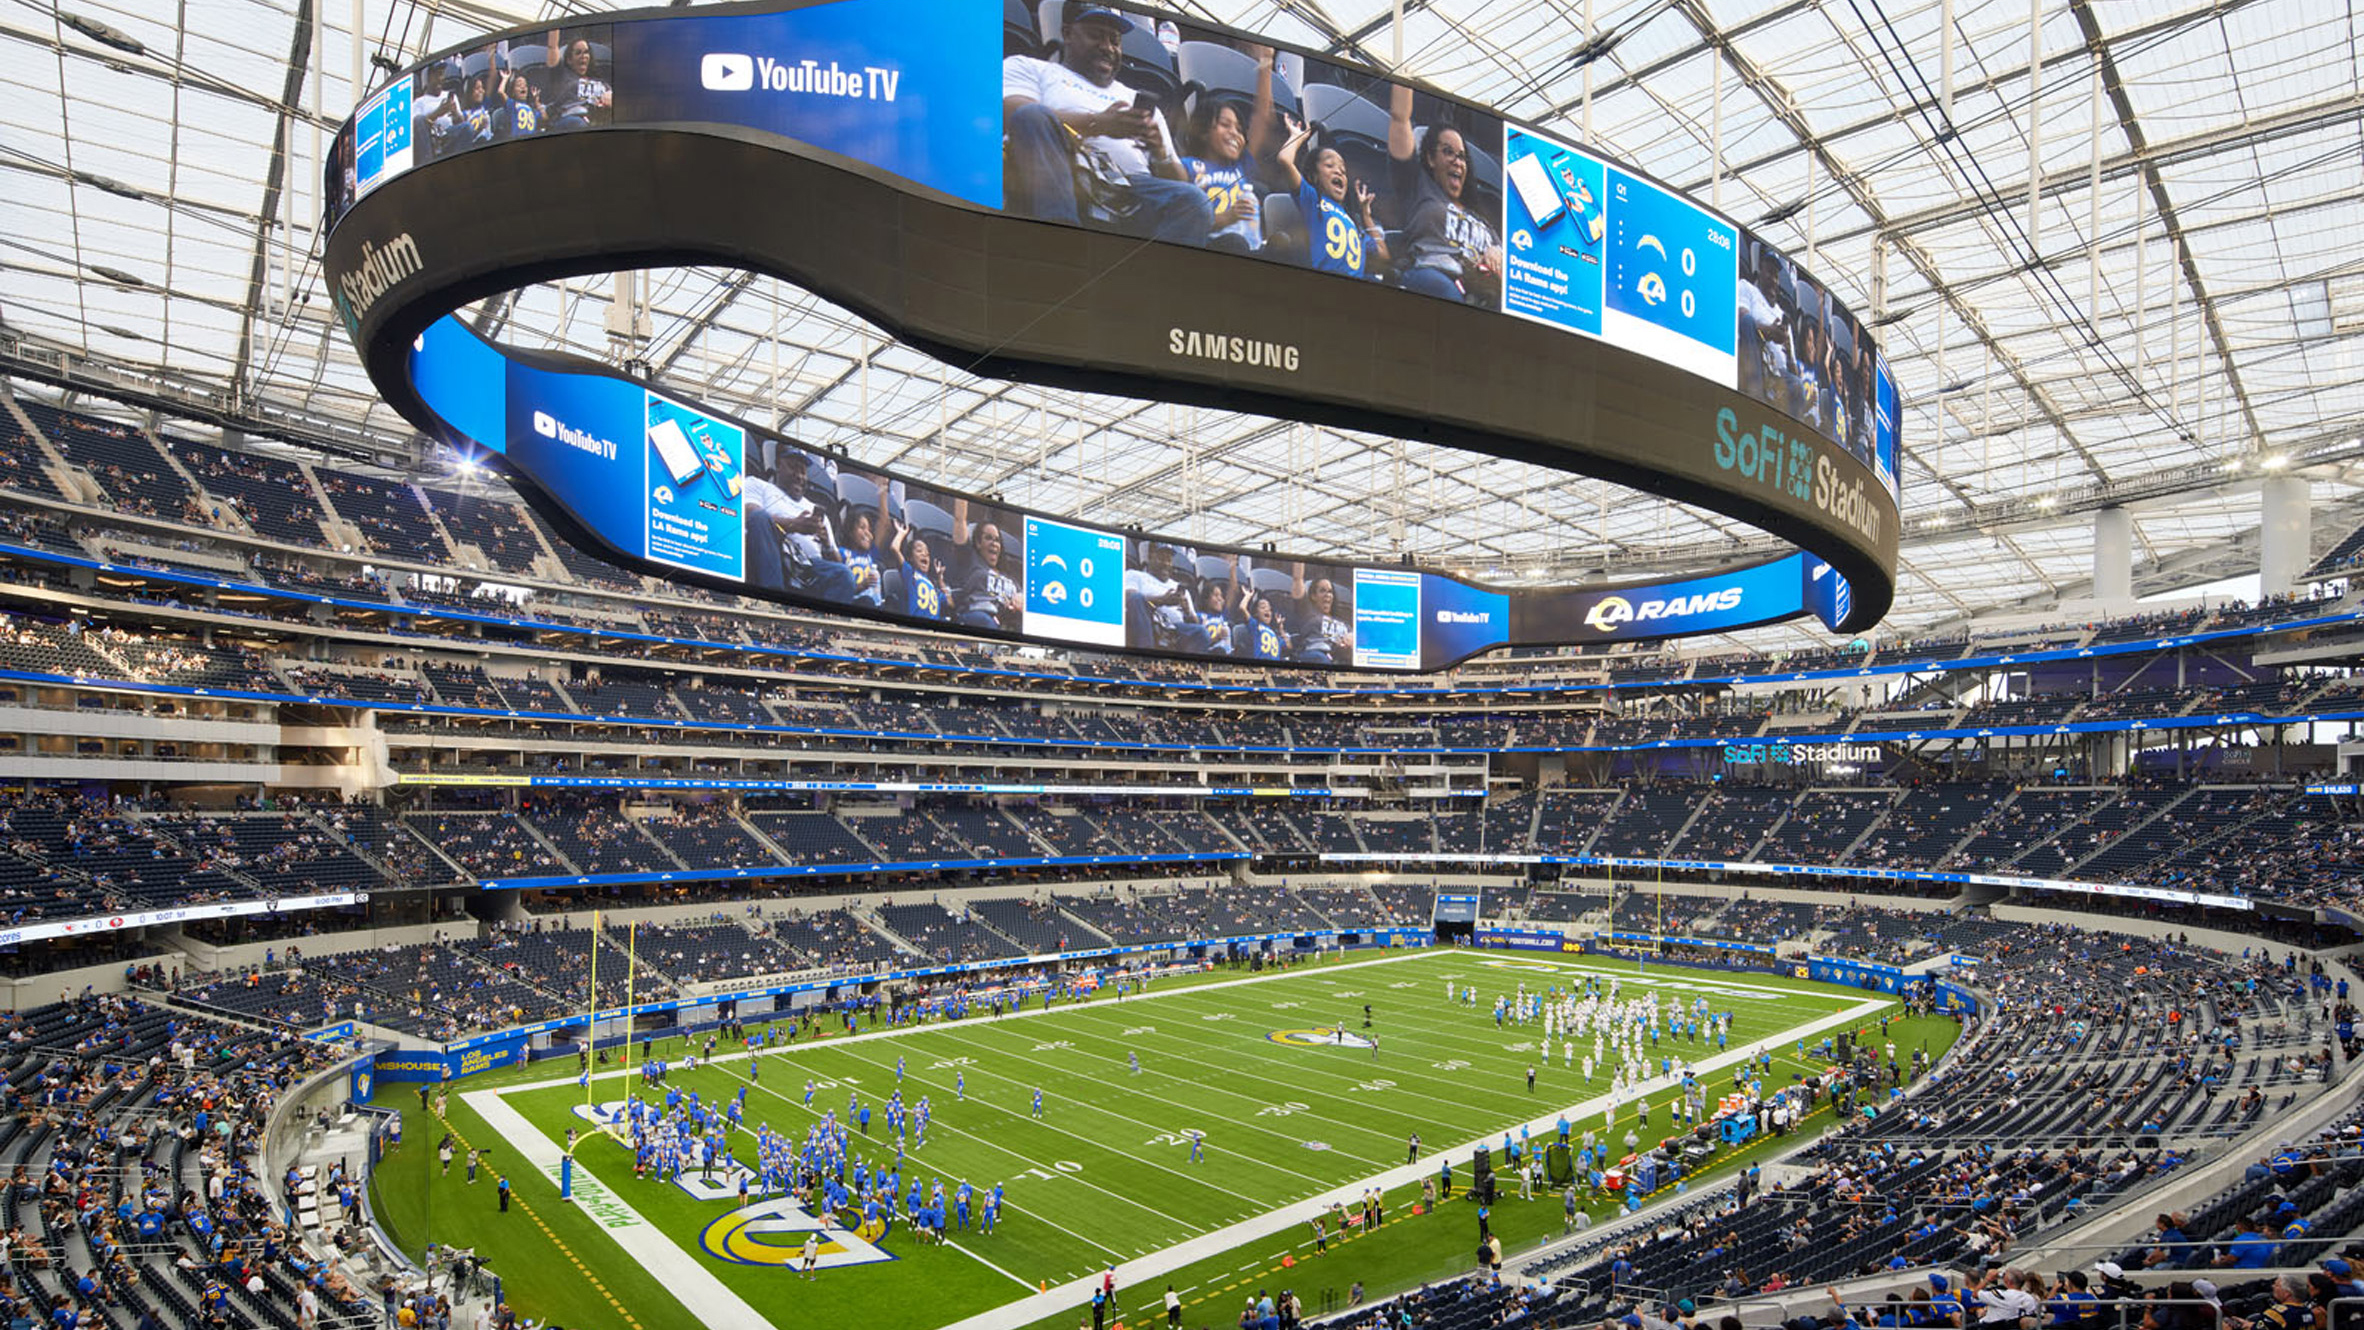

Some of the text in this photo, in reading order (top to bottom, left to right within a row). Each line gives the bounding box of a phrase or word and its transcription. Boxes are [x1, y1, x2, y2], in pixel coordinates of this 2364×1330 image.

[756, 57, 899, 102] YouTube TV
[1325, 217, 1362, 270] 99
[1510, 254, 1569, 281] Download the
[1682, 248, 1696, 277] 0
[341, 232, 424, 320] Stadium
[1510, 268, 1523, 281] LA
[1524, 272, 1548, 288] Rams
[1681, 289, 1695, 318] 0
[1169, 327, 1299, 371] SAMSUNG
[557, 421, 617, 460] YouTube TV
[1714, 407, 1784, 490] SoFi
[1815, 454, 1880, 546] Stadium
[652, 507, 693, 528] Download
[652, 519, 664, 531] LA
[1080, 557, 1094, 578] 0
[917, 582, 939, 616] 99
[1080, 587, 1094, 608] 0
[1637, 587, 1743, 622] RAMS
[1452, 612, 1490, 624] YouTube TV
[1260, 628, 1279, 659] 99
[1724, 743, 1881, 763] SoFi Stadium
[461, 1050, 482, 1061] LOS
[461, 1050, 509, 1068] ANGELES
[461, 1061, 490, 1075] RAMS
[1264, 1101, 1311, 1117] 30
[1155, 1128, 1207, 1147] 20
[1024, 1160, 1083, 1181] 10
